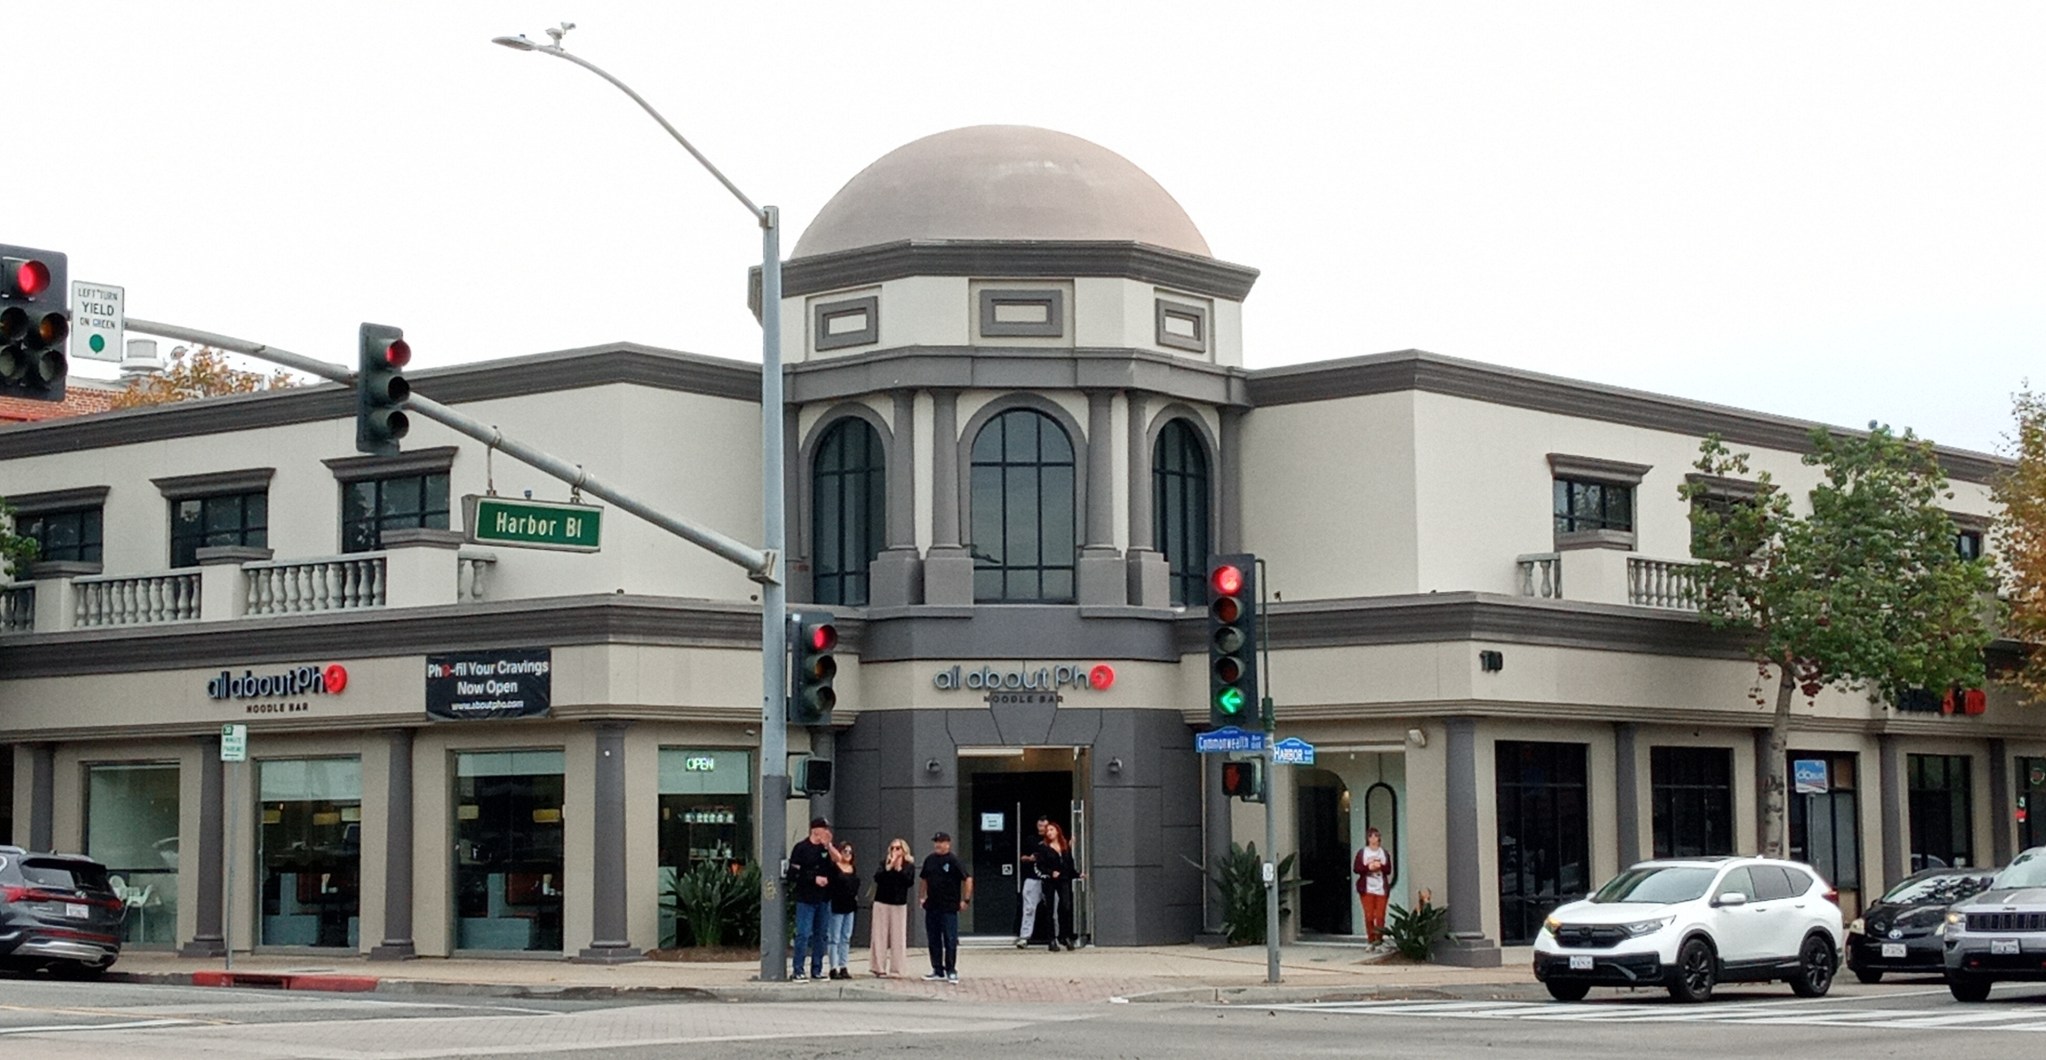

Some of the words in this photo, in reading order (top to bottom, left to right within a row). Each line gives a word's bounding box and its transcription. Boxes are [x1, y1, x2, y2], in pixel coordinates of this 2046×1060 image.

[78, 288, 95, 298] LEFT
[100, 290, 118, 300] TURN
[82, 301, 114, 316] YIELD
[80, 317, 90, 326] ON
[496, 512, 556, 536] Harbor
[566, 517, 582, 538] Bl
[469, 662, 496, 676] Your
[497, 660, 549, 676] Cravings
[208, 671, 230, 699] all
[231, 670, 298, 698] about
[934, 665, 960, 690] all
[966, 665, 1048, 690] about
[457, 681, 484, 695] Now
[486, 680, 518, 696] Open
[246, 703, 285, 713] NOODLE
[289, 702, 308, 712] BAR
[1273, 746, 1303, 761] HARBOR
[687, 757, 714, 770] OPEN
